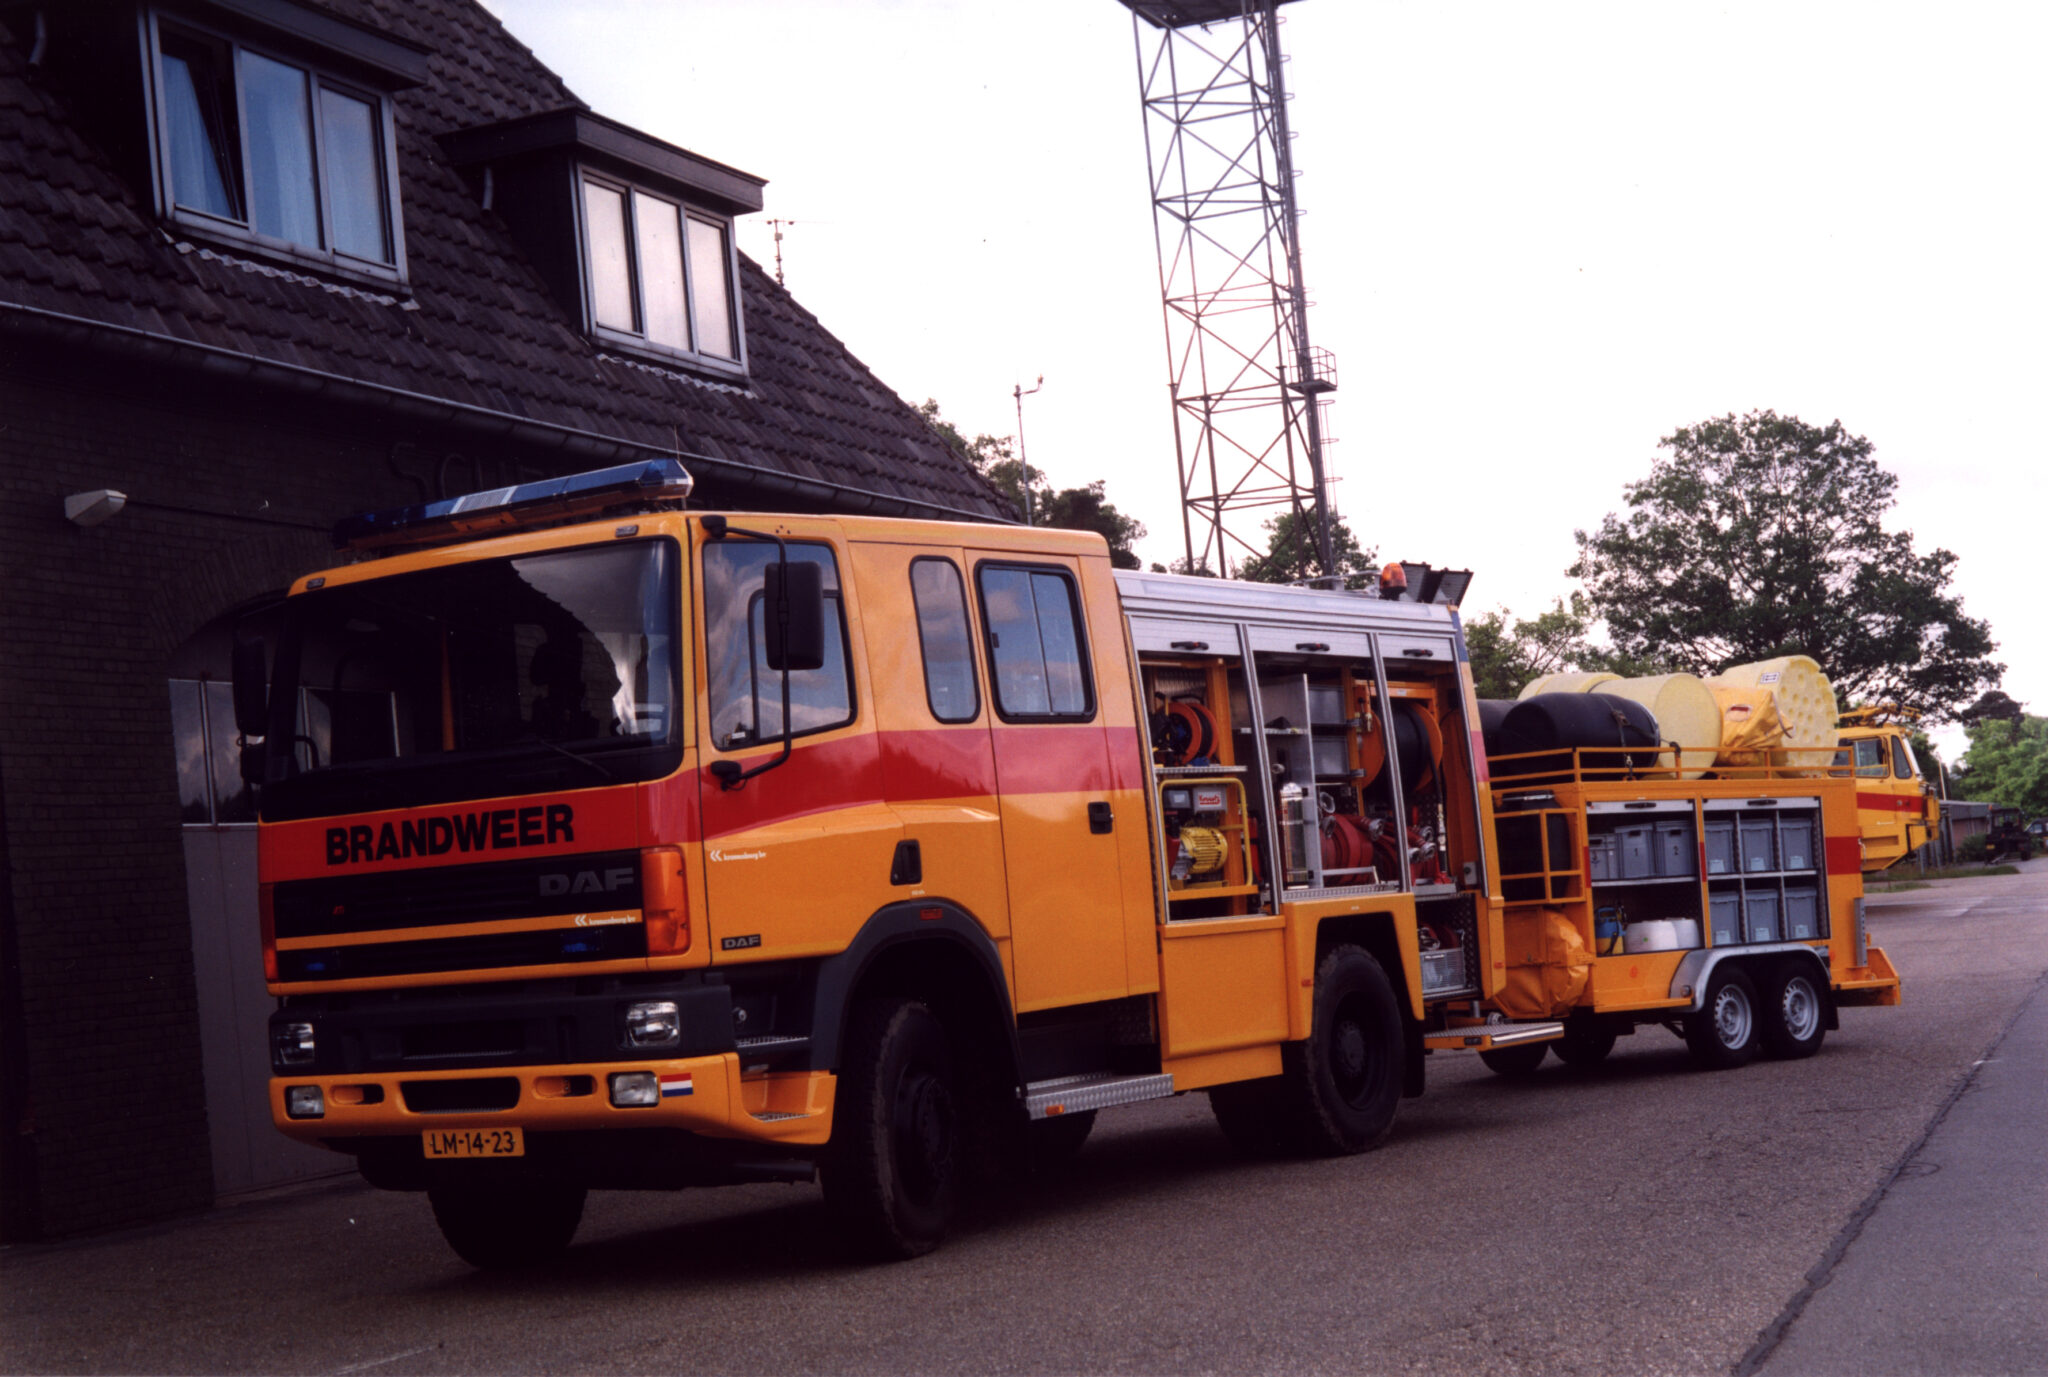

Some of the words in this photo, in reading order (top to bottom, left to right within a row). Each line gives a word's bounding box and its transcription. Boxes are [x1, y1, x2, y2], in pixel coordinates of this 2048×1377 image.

[326, 803, 574, 866] BRANDWEER
[539, 867, 635, 897] DAF
[724, 935, 760, 949] DAF
[431, 1130, 515, 1155] LM-14-23
